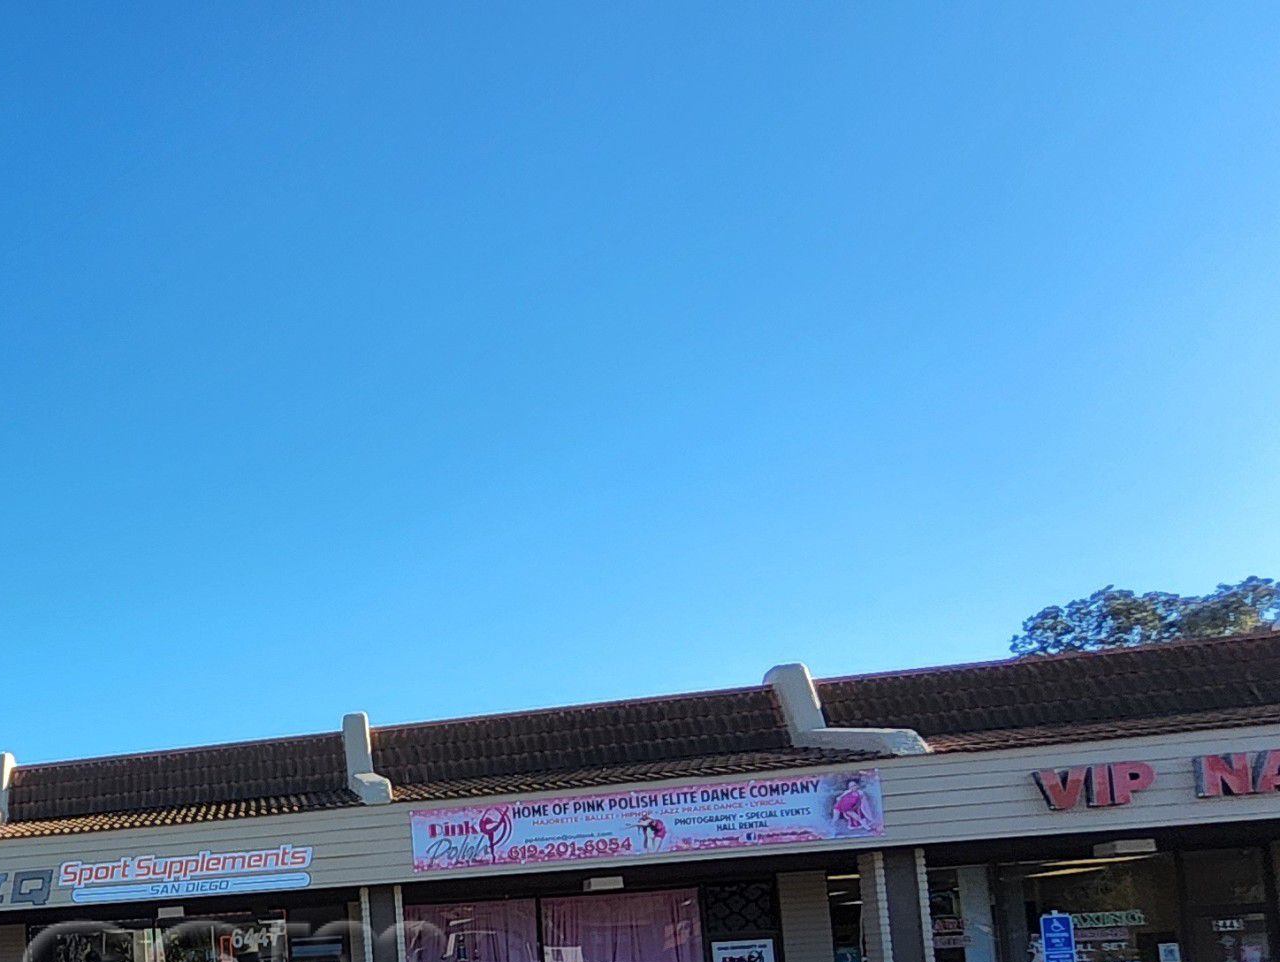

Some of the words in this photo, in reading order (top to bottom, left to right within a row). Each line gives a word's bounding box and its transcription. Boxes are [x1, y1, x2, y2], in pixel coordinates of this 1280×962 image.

[1033, 762, 1156, 810] VIP
[512, 804, 549, 819] HOME
[552, 803, 570, 816] OF
[573, 799, 605, 815] PINK
[609, 794, 658, 811] POLISH
[662, 791, 698, 806] ELITE
[700, 785, 747, 803] DANCE
[749, 779, 821, 799] COMPANY
[674, 814, 738, 826] PHOTOGRAPHY
[745, 810, 778, 820] SPECIAL
[780, 807, 811, 817] EVENTS
[716, 823, 737, 832] HALL
[738, 820, 769, 830] RENTAL
[429, 821, 479, 838] Pink
[426, 835, 490, 866] Polish
[507, 837, 633, 860] 619-201-6054
[61, 861, 128, 887] Sport
[135, 848, 308, 880] Supplements
[150, 883, 180, 895] SAN
[185, 880, 230, 894] DIEGO
